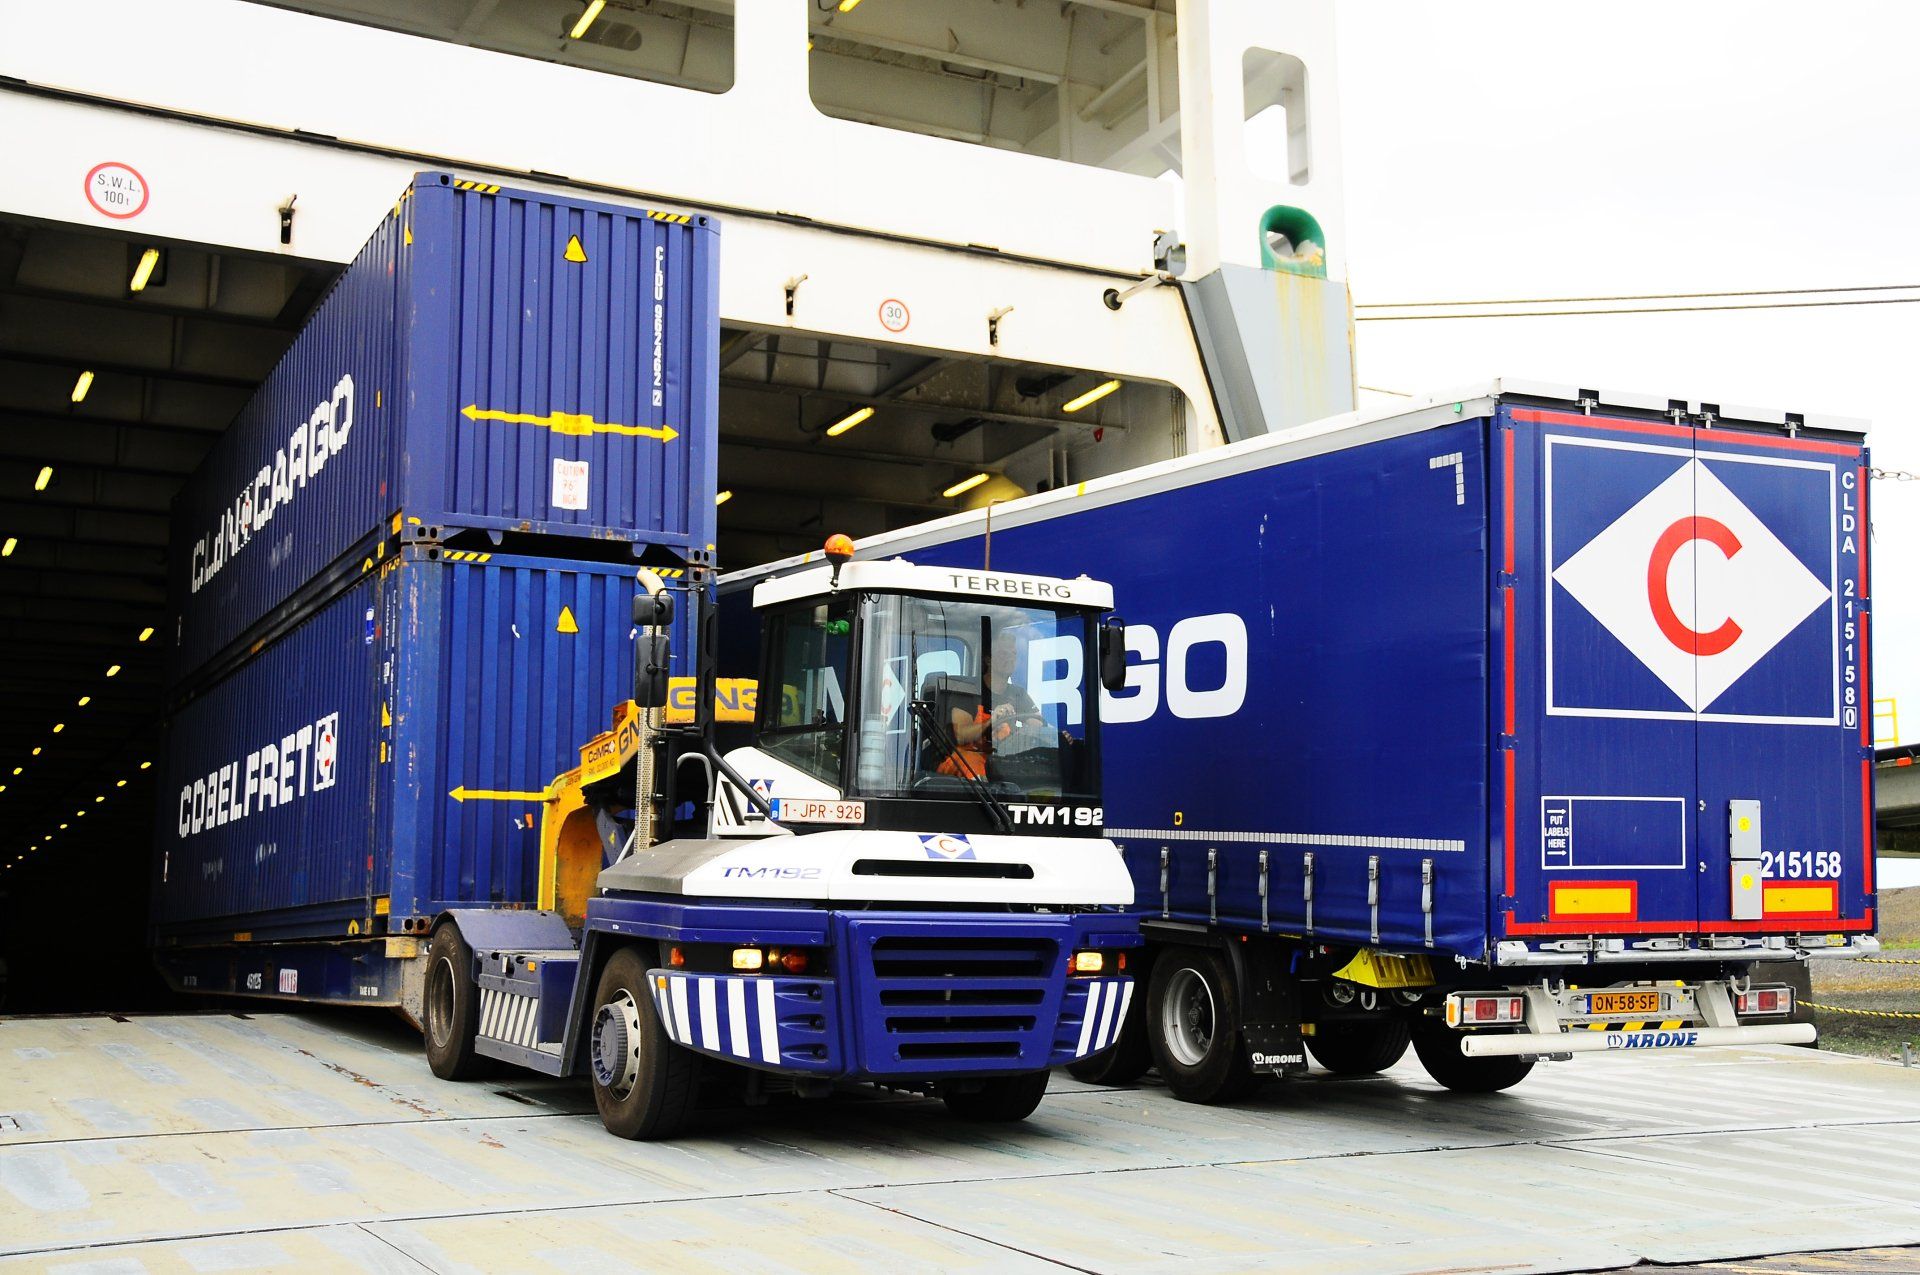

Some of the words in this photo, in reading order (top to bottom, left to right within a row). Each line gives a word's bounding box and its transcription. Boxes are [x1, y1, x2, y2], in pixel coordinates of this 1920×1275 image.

[887, 306, 902, 319] 30
[253, 373, 355, 532] CARGO
[1841, 471, 1856, 554] CLDA
[948, 574, 1072, 599] TERBERG
[1647, 515, 1743, 657] C
[178, 724, 313, 839] COBELFRET
[1007, 805, 1104, 826] TM192
[1549, 815, 1564, 826] PUT
[1544, 827, 1570, 837] LABELS
[1547, 838, 1567, 849] HERE
[722, 866, 822, 880] TM192
[1760, 850, 1842, 878] 215158
[1595, 995, 1656, 1011] ON-58-SF
[1624, 1031, 1698, 1049] KRONE
[1265, 1054, 1303, 1065] KRONE
